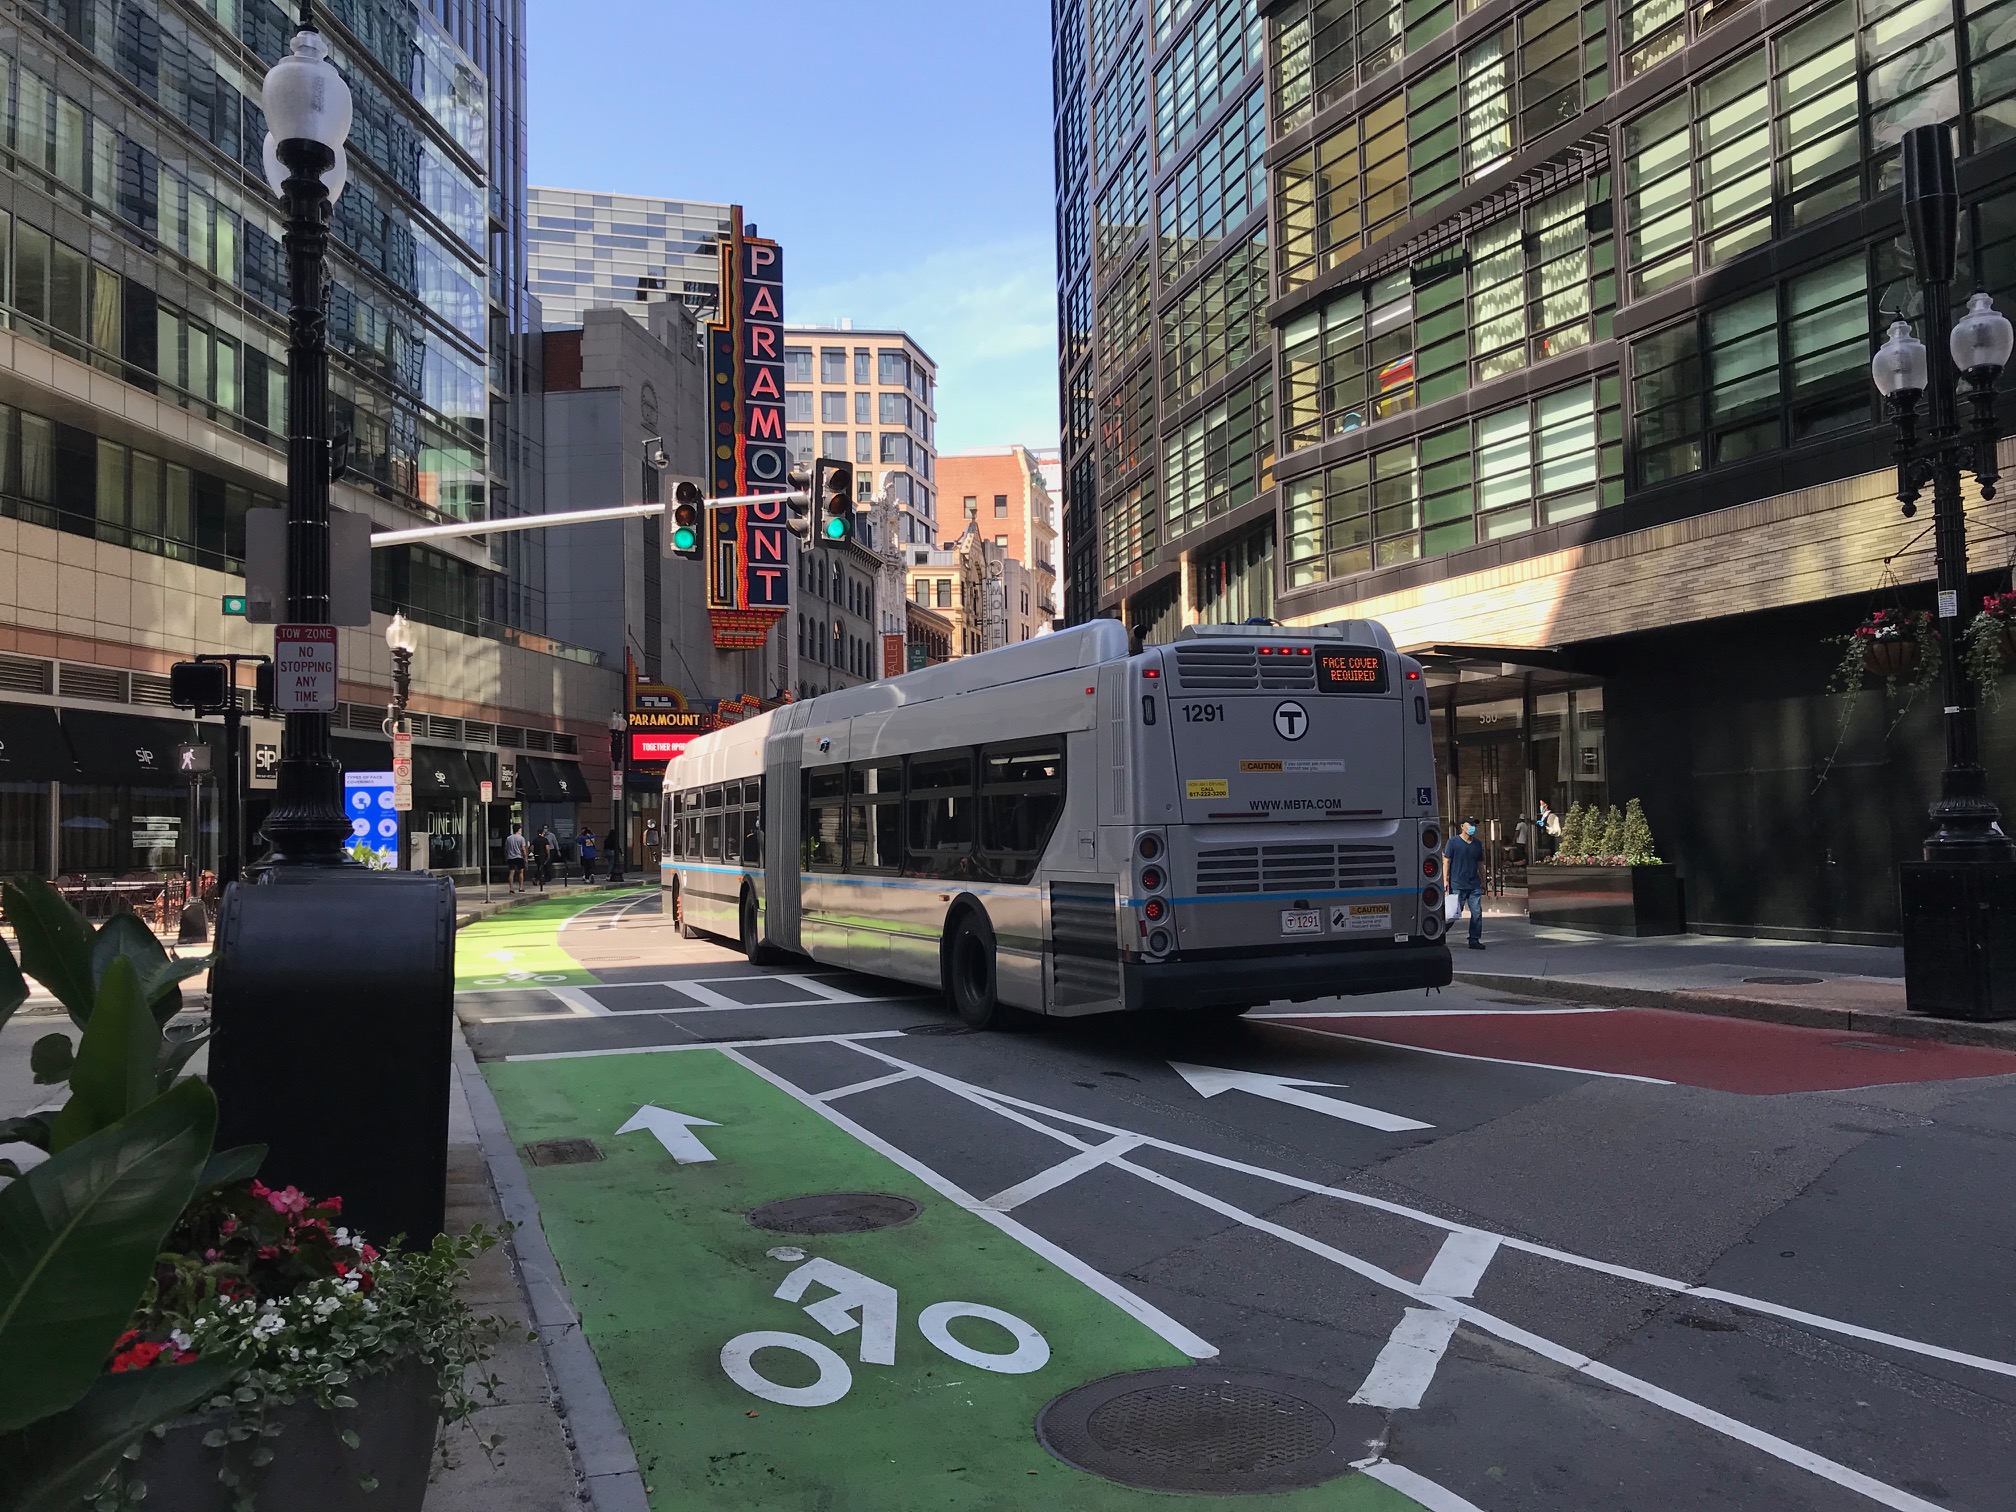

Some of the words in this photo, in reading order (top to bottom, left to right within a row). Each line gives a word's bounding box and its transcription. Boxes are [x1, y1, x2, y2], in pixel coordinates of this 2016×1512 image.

[750, 245, 782, 601] PARAMOUNT
[281, 628, 300, 638] TOW
[305, 629, 332, 639] ZONE
[299, 646, 314, 658] NO
[280, 661, 332, 673] STOPPING
[1322, 657, 1346, 669] FACE
[1348, 657, 1379, 669] COVER
[295, 676, 317, 687] ANY
[1330, 670, 1376, 681] REQUIRED
[294, 690, 318, 702] TIME
[1182, 704, 1224, 722] 1291
[629, 713, 700, 726] PARAMOUNT
[1279, 711, 1302, 734] T
[642, 742, 670, 751] TOGETHER
[1250, 799, 1341, 810] WWW.MBTA.COM
[427, 811, 450, 835] DINE
[452, 812, 461, 835] IN
[1357, 905, 1389, 914] CAUTION
[1298, 916, 1318, 928] 1291
